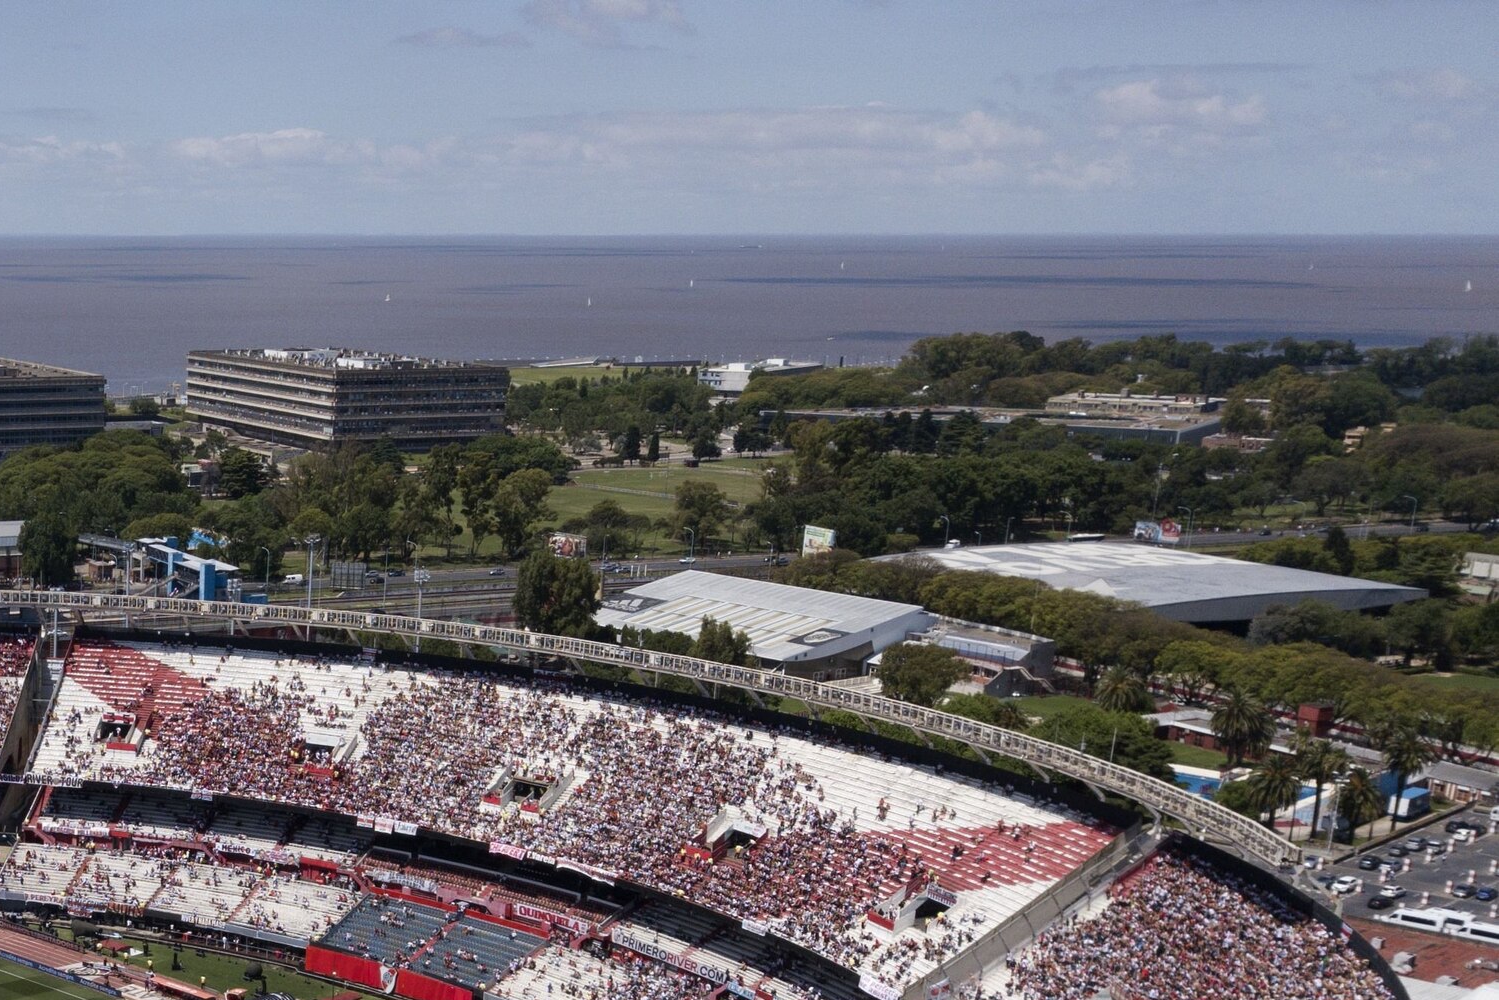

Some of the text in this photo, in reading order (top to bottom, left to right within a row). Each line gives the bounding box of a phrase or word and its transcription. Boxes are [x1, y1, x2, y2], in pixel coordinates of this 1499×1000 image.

[27, 774, 83, 787] RIVER TOUR
[221, 844, 251, 854] MEXICO
[621, 936, 724, 983] PRIMERORIVER.COM
